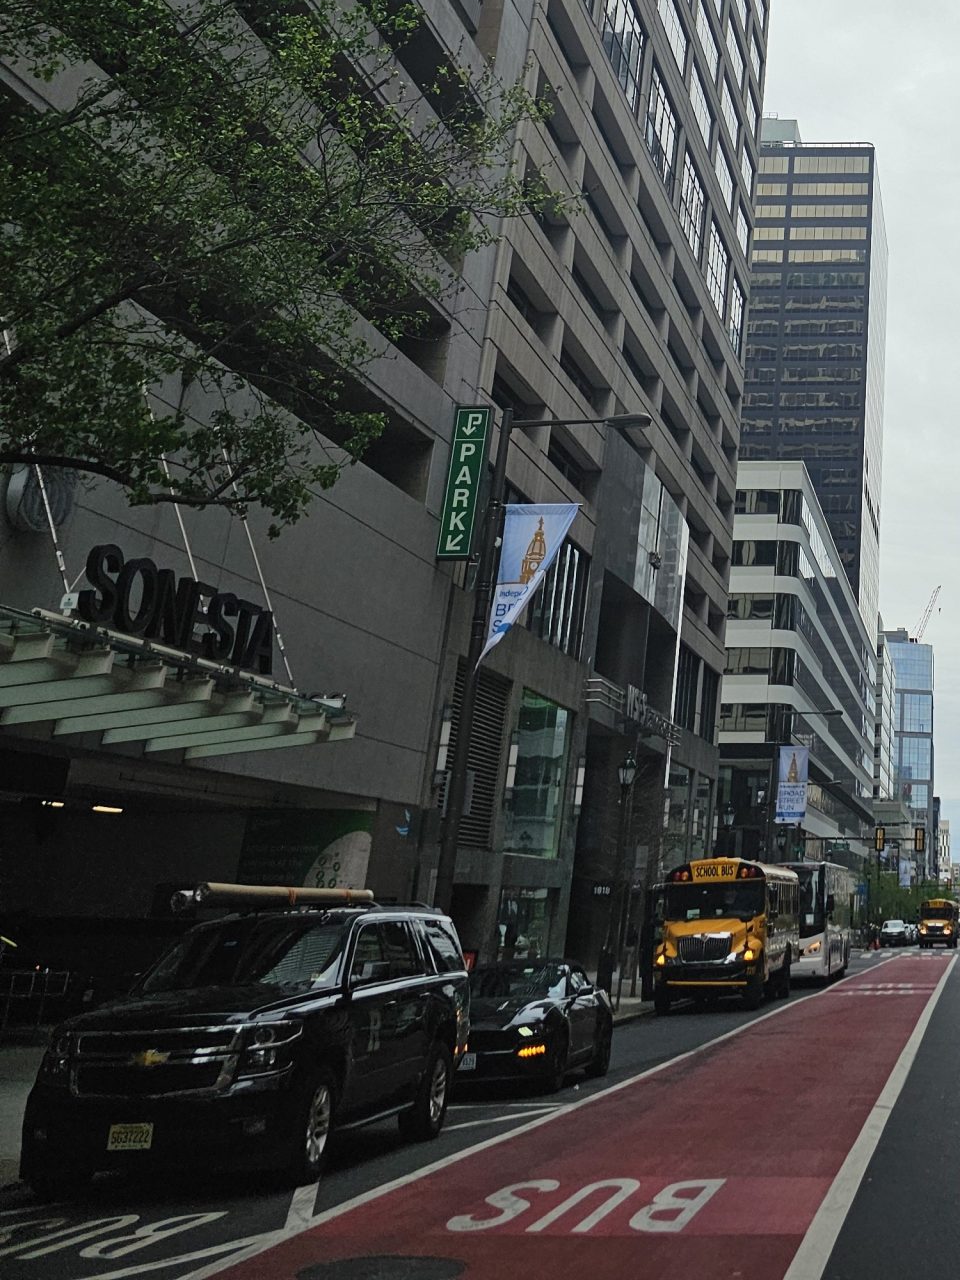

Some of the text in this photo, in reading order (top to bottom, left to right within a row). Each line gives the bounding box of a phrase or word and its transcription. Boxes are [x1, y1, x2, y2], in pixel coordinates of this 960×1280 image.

[449, 444, 475, 531] PARK
[78, 544, 273, 675] SONESTA
[695, 864, 734, 878] SCHOOL BUS
[445, 1178, 728, 1232] BUS
